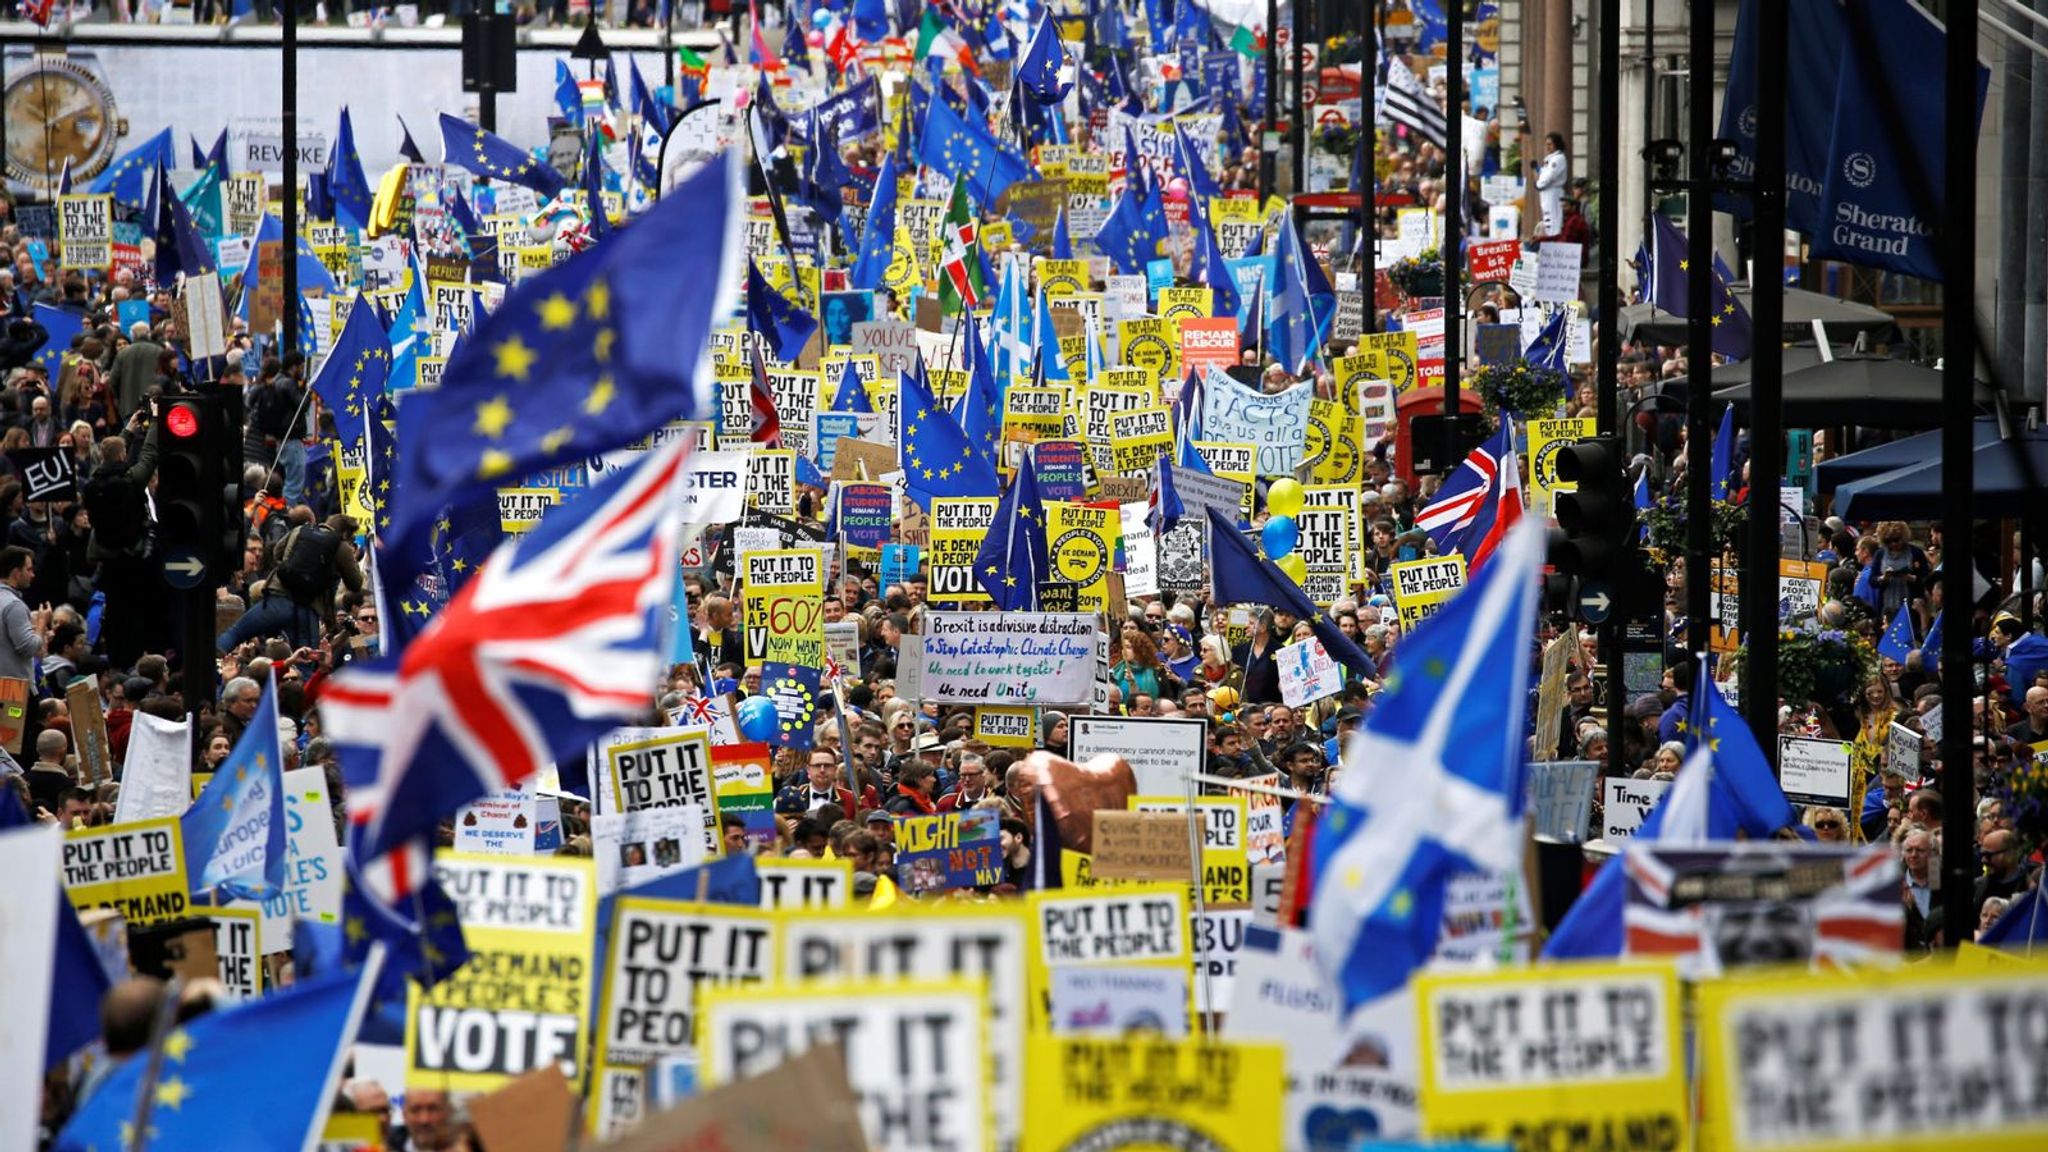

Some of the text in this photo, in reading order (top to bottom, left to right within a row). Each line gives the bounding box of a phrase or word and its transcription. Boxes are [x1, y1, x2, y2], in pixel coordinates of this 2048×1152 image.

[250, 145, 324, 163] REVKE
[1727, 157, 1823, 196] Shton
[63, 200, 104, 213] PUT IT
[64, 214, 105, 225] TO THE
[1836, 202, 1934, 236] Sherato
[65, 226, 106, 238] PEOPLE
[1833, 226, 1909, 256] Grand
[1477, 244, 1512, 256] Brexit:
[1475, 267, 1507, 279] worth
[1184, 330, 1235, 339] REMAIN
[1184, 339, 1235, 348] LABOUR
[422, 364, 442, 374] PUT
[768, 376, 816, 393] PUT IT
[788, 394, 814, 409] THE
[1010, 392, 1060, 404] PUT IT TO
[1090, 391, 1119, 408] PUT
[1010, 404, 1059, 413] THE PEOPLE
[1090, 408, 1105, 422] TO
[1114, 412, 1165, 429] PUT IT TO
[1540, 419, 1583, 430] PUT IT TO
[1116, 423, 1167, 438] THE PEOPLE
[1237, 426, 1256, 440] us
[1558, 429, 1583, 438] PEOPLE
[1037, 455, 1081, 463] STUDENTS
[1222, 449, 1233, 460] IT
[25, 450, 72, 492] EU!
[775, 457, 789, 473] IT
[765, 475, 789, 490] THE
[1037, 473, 1082, 483] PEOPLE'S
[1046, 486, 1073, 496] VOTE
[519, 496, 533, 508] IT
[845, 498, 890, 507] STUDENTS
[937, 504, 992, 517] PUT IT TO
[1061, 508, 1106, 520] PUT IT TO
[843, 516, 890, 526] PEOPLE'S
[937, 518, 992, 528] THE PEOPLE
[1061, 519, 1105, 528] THE PEOPLE
[1325, 514, 1341, 531] IT
[853, 530, 880, 539] VOTE
[1310, 532, 1341, 548] THE
[933, 540, 947, 551] WE
[751, 556, 814, 572] PUT IT TO
[932, 553, 939, 564] A
[750, 571, 815, 584] THE PEOPLE
[1400, 563, 1458, 584] PUT IT TO
[1402, 577, 1461, 594] THE PEOPLE
[748, 597, 764, 611] WE
[1078, 595, 1102, 607] 2019
[770, 597, 822, 634] 60%
[1402, 606, 1416, 620] WE
[934, 617, 974, 633] Brexit
[1039, 616, 1092, 635] distraction
[768, 639, 821, 652] NOW WANT
[1021, 637, 1057, 656] Climate
[1059, 637, 1088, 659] Change
[948, 662, 969, 675] need
[939, 683, 1036, 700] We need Unity
[981, 715, 1028, 727] PUT IT TO
[981, 726, 1028, 735] THE PEOPLE
[620, 744, 699, 780] PUT IT
[623, 780, 651, 804] TO
[659, 770, 705, 798] THE
[1614, 786, 1650, 805] Time
[893, 813, 961, 853] MIGHT
[64, 831, 169, 866] PUT IT TO
[949, 847, 992, 871] NOT
[65, 854, 171, 885] THE PEOPLE
[976, 868, 1002, 886] MAY
[505, 871, 577, 901] IT TO
[486, 900, 573, 925] PEOPLE
[1044, 901, 1173, 935] PUT IT TO
[627, 919, 768, 969] PUT IT
[1046, 930, 1174, 959] THE PEOPLE
[625, 967, 671, 1006] TO
[447, 981, 581, 1008] PEOPLE'S
[1440, 987, 1654, 1038] PUT IT TO
[1890, 1002, 1951, 1063] IT
[418, 1005, 577, 1077] VOTE
[896, 1014, 954, 1076] IT
[1443, 1034, 1654, 1078] THE PEOPLE
